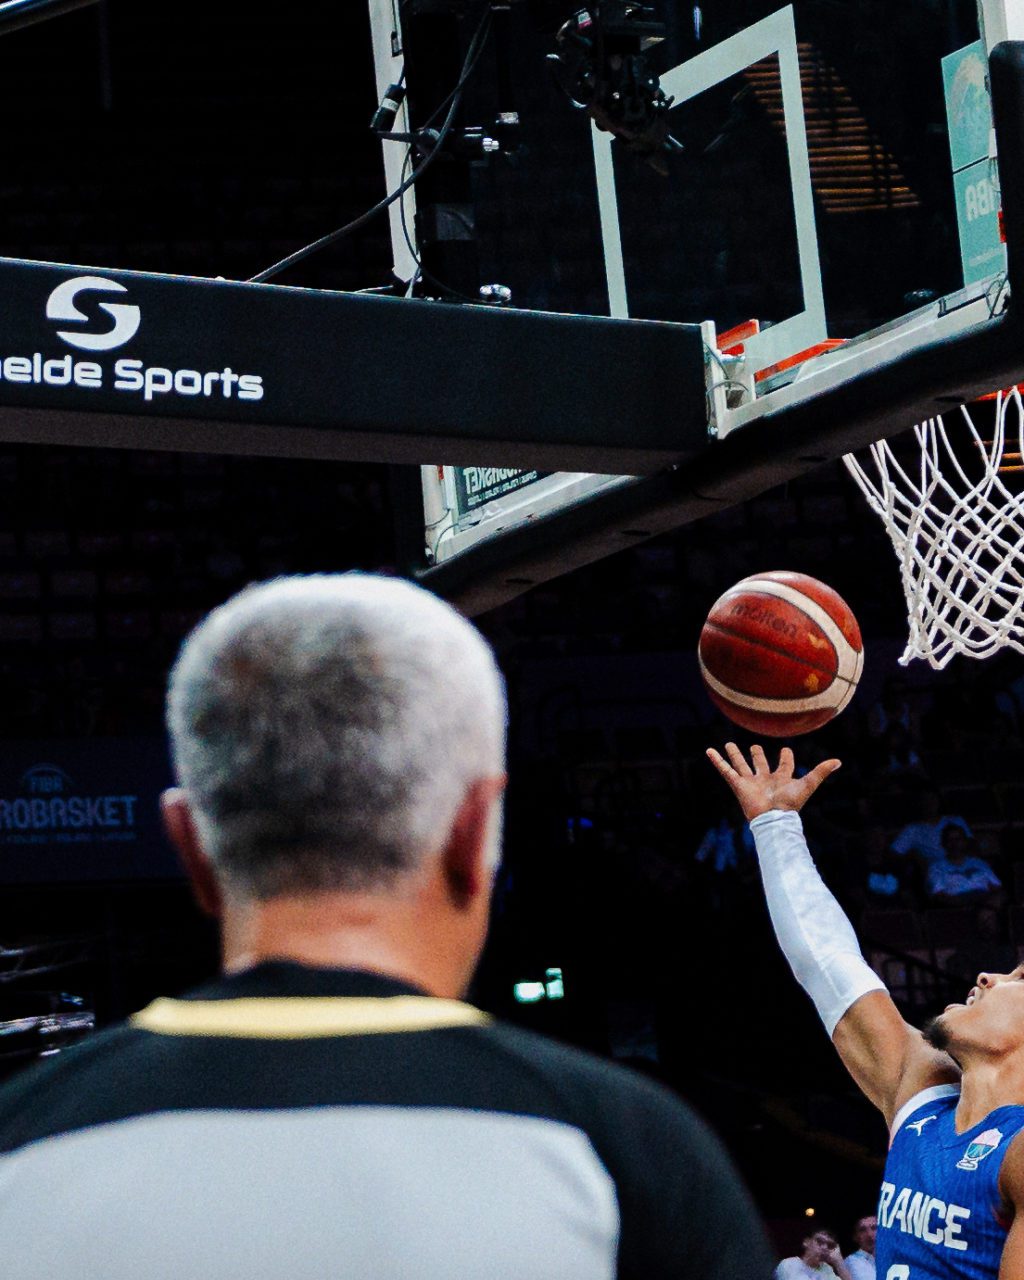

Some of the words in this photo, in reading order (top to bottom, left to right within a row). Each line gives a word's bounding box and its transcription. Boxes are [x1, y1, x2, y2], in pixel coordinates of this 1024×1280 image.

[0, 352, 102, 388] elde
[114, 358, 264, 401] Sports
[877, 1180, 971, 1251] RANCE
